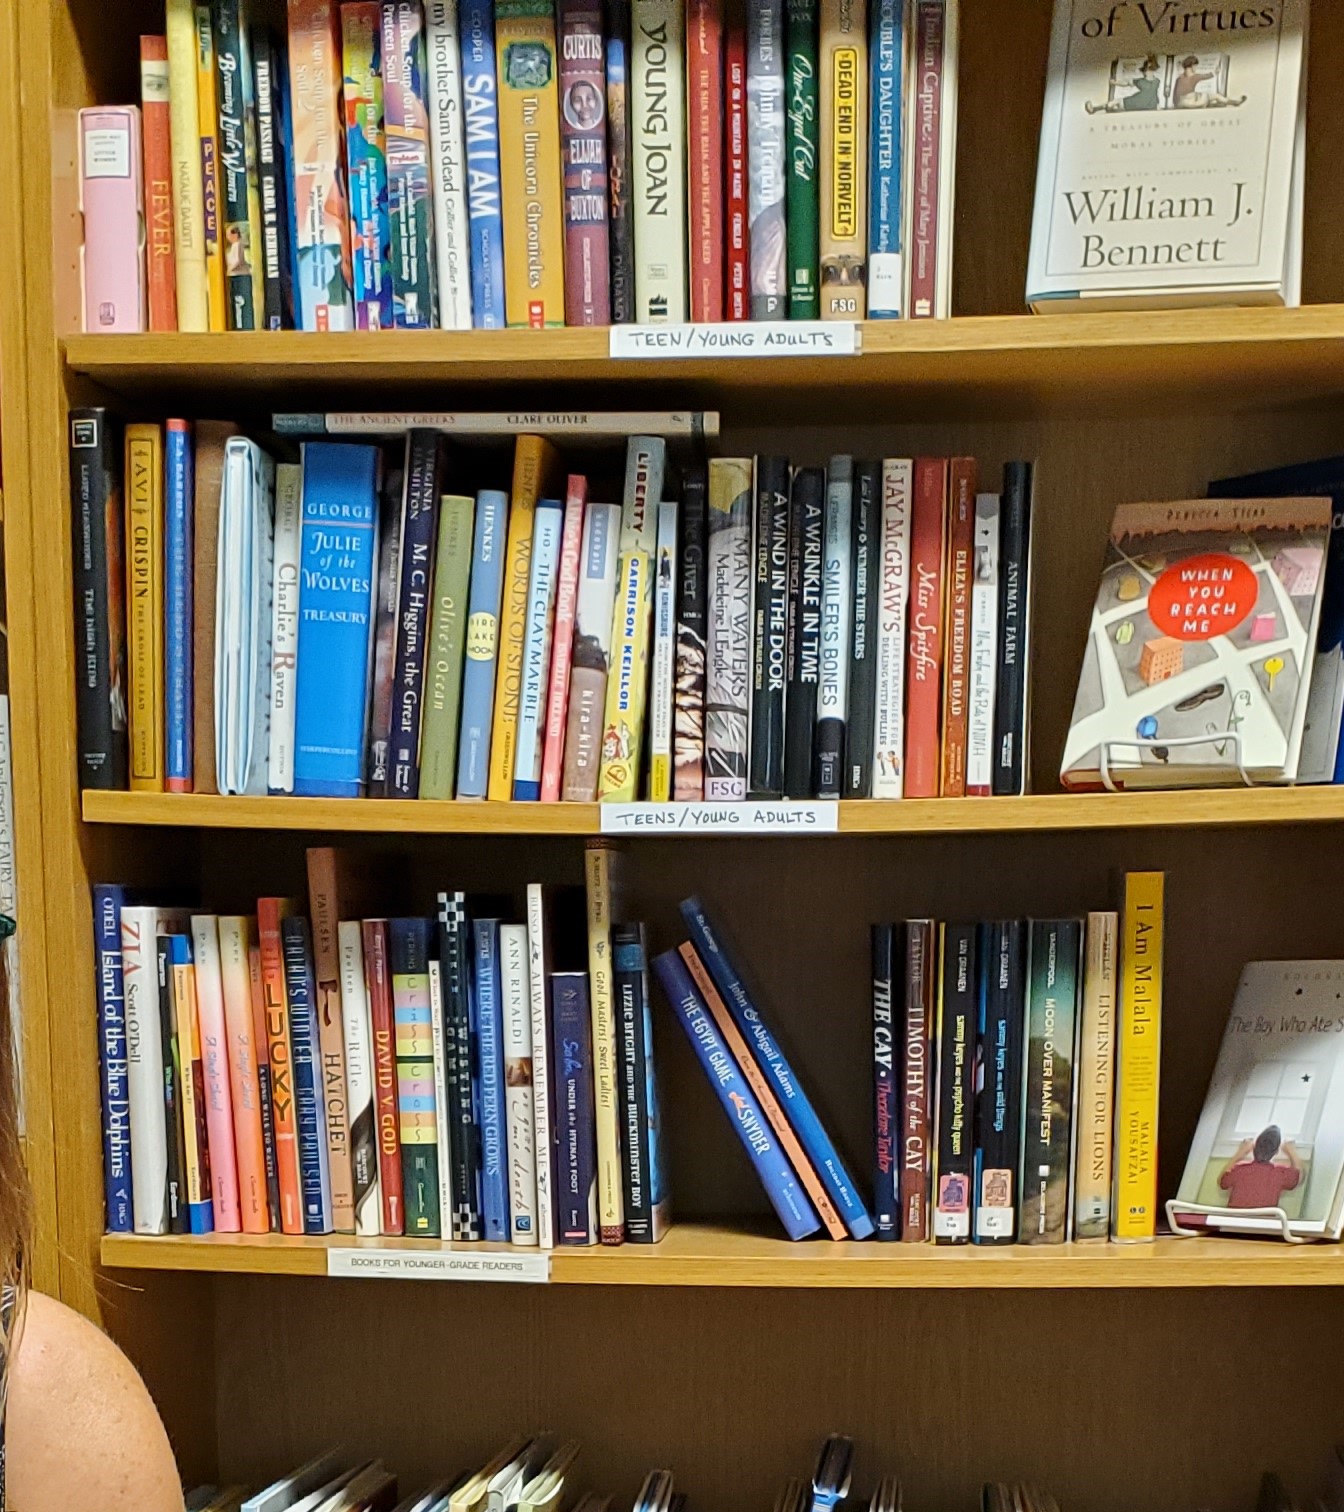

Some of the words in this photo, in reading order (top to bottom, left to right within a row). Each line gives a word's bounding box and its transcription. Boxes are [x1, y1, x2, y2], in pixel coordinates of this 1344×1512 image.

[430, 2, 448, 28] my
[1081, 3, 1128, 38] of
[1137, 2, 1275, 34] Virtues
[435, 34, 453, 95] brother
[639, 21, 669, 135] YOUNG
[838, 60, 852, 99] DEAD
[437, 98, 454, 136] Sam
[465, 74, 494, 141] SAM
[524, 96, 539, 124] The
[789, 54, 812, 143] One-Eyed
[838, 106, 851, 133] END
[440, 140, 456, 153] is
[524, 132, 540, 195] Unicorn
[794, 147, 812, 180] Cat
[839, 141, 851, 155] IN
[441, 157, 458, 192] dead
[642, 142, 671, 217] JOAN
[838, 161, 851, 226] NORVELT
[469, 170, 498, 219] AM
[1063, 185, 1215, 225] William
[1227, 182, 1253, 227] J.
[152, 180, 170, 256] FEVER
[526, 201, 543, 289] Chronicles
[1080, 234, 1227, 268] Bennett
[831, 299, 856, 313] FSG
[765, 332, 833, 346] ADULTS
[632, 453, 648, 532] LIBERTY
[805, 504, 821, 518] A
[412, 543, 427, 565] M.
[802, 522, 821, 605] WRINKLE
[412, 570, 425, 588] C.
[1180, 569, 1233, 582] WHEN
[1189, 586, 1225, 598] YOU
[625, 558, 639, 637] GARRISON
[1170, 603, 1236, 616] REACH
[404, 592, 423, 656] Higgins,
[437, 597, 456, 653] Olive's
[802, 612, 820, 633] IN
[1183, 620, 1209, 633] ME
[405, 659, 419, 684] the
[619, 645, 633, 710] KEILLOR
[801, 637, 819, 683] TIME
[433, 661, 451, 710] Ocean
[401, 687, 418, 732] Great
[754, 811, 816, 824] ADULTS
[1134, 921, 1153, 955] Am
[101, 949, 124, 1001] Island
[480, 967, 495, 1013] WHERE
[104, 1004, 123, 1025] of
[1132, 964, 1153, 1036] Malala
[105, 1028, 125, 1056] the
[481, 1016, 496, 1052] THE
[106, 1058, 128, 1097] Blue
[375, 1030, 392, 1088] DAVID
[483, 1056, 497, 1084] RED
[324, 1053, 346, 1156] HATCHET
[379, 1095, 394, 1108] V.
[483, 1087, 499, 1123] FERN
[106, 1100, 132, 1177] Dolphins
[381, 1114, 396, 1155] GOD
[485, 1126, 500, 1176] GROWS
[351, 1258, 380, 1267] BOOKS
[383, 1258, 401, 1268] FOR
[483, 1262, 523, 1271] READERS
